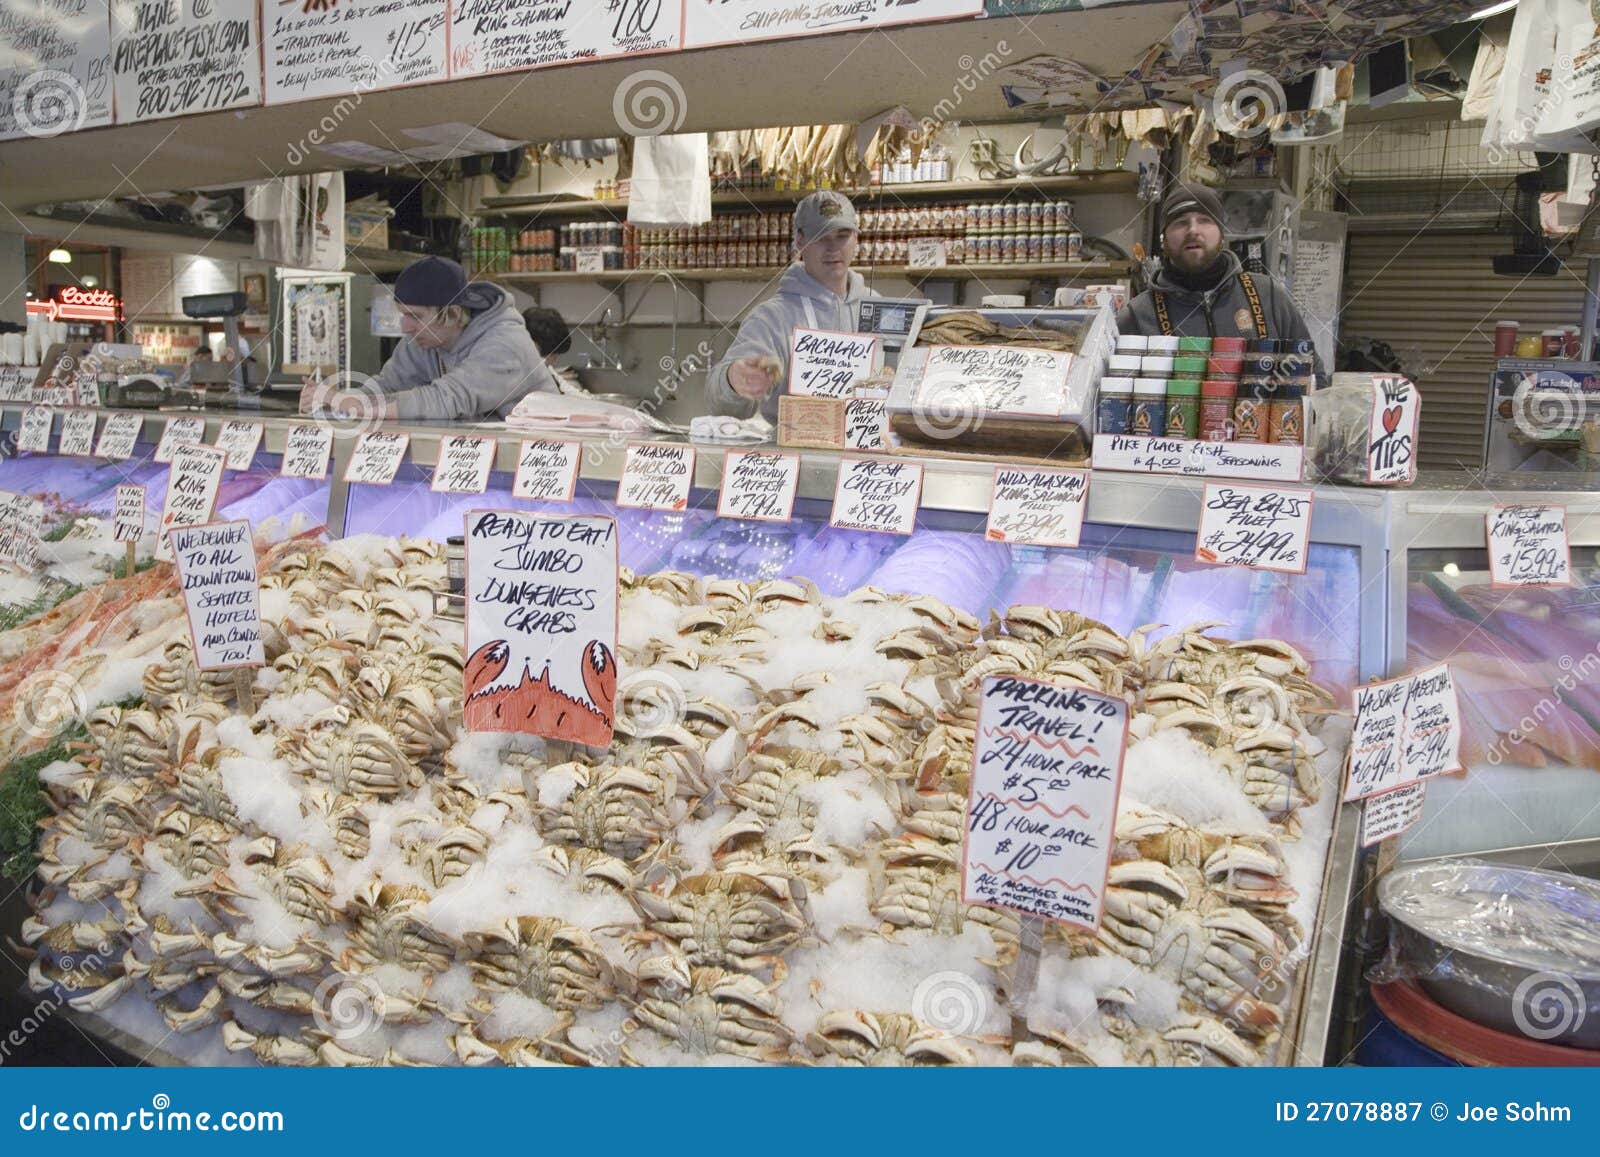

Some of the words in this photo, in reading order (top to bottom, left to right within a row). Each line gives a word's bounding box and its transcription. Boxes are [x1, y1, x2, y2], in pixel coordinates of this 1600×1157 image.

[330, 9, 341, 24] 3
[344, 8, 367, 21] BEST
[474, 16, 508, 36] KING
[512, 2, 572, 26] SALMON
[740, 8, 811, 30] SHIPPING
[534, 29, 565, 42] SAUCE
[491, 45, 529, 57] TARTAR
[533, 40, 567, 54] SAUCE
[137, 86, 170, 117] 800
[795, 334, 876, 360] BACALAO!
[1380, 377, 1411, 405] WE
[852, 416, 876, 425] MIX
[450, 436, 485, 448] FRESH
[530, 440, 565, 451] FRESH
[1111, 436, 1139, 450] PIKE
[1146, 439, 1184, 454] PLACE
[1190, 443, 1231, 456] FISH
[636, 445, 684, 461] ALASKAN
[739, 451, 785, 466] FRESH
[1217, 456, 1281, 468] SEASONING
[1370, 434, 1411, 471] TIPS
[626, 459, 662, 474] BLACK
[664, 460, 687, 475] COD
[852, 460, 908, 477] FRESH
[174, 474, 206, 496] KING
[731, 478, 788, 492] CATFISH
[843, 474, 915, 496] CATFISH
[996, 471, 1028, 486] WILD
[1028, 473, 1086, 491] ALASKAN
[171, 495, 205, 510] CRAB
[995, 487, 1029, 500] KING
[1030, 488, 1086, 502] SALMON
[1207, 489, 1252, 513] SEA
[1253, 493, 1312, 518] BASS
[1499, 505, 1551, 518] FRESH
[472, 513, 535, 550] READY
[538, 522, 565, 540] TO
[566, 522, 614, 548] EAT!
[1490, 520, 1520, 537] KING
[1522, 519, 1565, 535] SALMON
[177, 530, 198, 552] WE
[199, 527, 247, 547] DELIVER
[185, 551, 207, 568] TO
[209, 549, 241, 566] ALL
[494, 542, 583, 573] JUMBO
[184, 568, 256, 590] DOWNTOWN
[196, 590, 252, 608] SEATTLE
[475, 576, 597, 611] DUNGENESS
[205, 609, 257, 628] HOTELS
[504, 606, 577, 635] CRABS
[202, 632, 226, 648] AND
[215, 645, 252, 663] TOO!
[986, 677, 1087, 712] PACKING
[1087, 698, 1117, 717] TO
[1374, 686, 1404, 712] SURE
[999, 705, 1103, 743] TRAVEL!
[980, 736, 1030, 772] 24
[1020, 752, 1065, 774] HOUR
[1066, 761, 1112, 781] PACK
[970, 797, 1007, 832] 48
[1005, 815, 1051, 837] HOUR
[1050, 826, 1098, 848] PACK
[975, 873, 999, 886] ALL
[1001, 880, 1058, 899] PACKAGES
